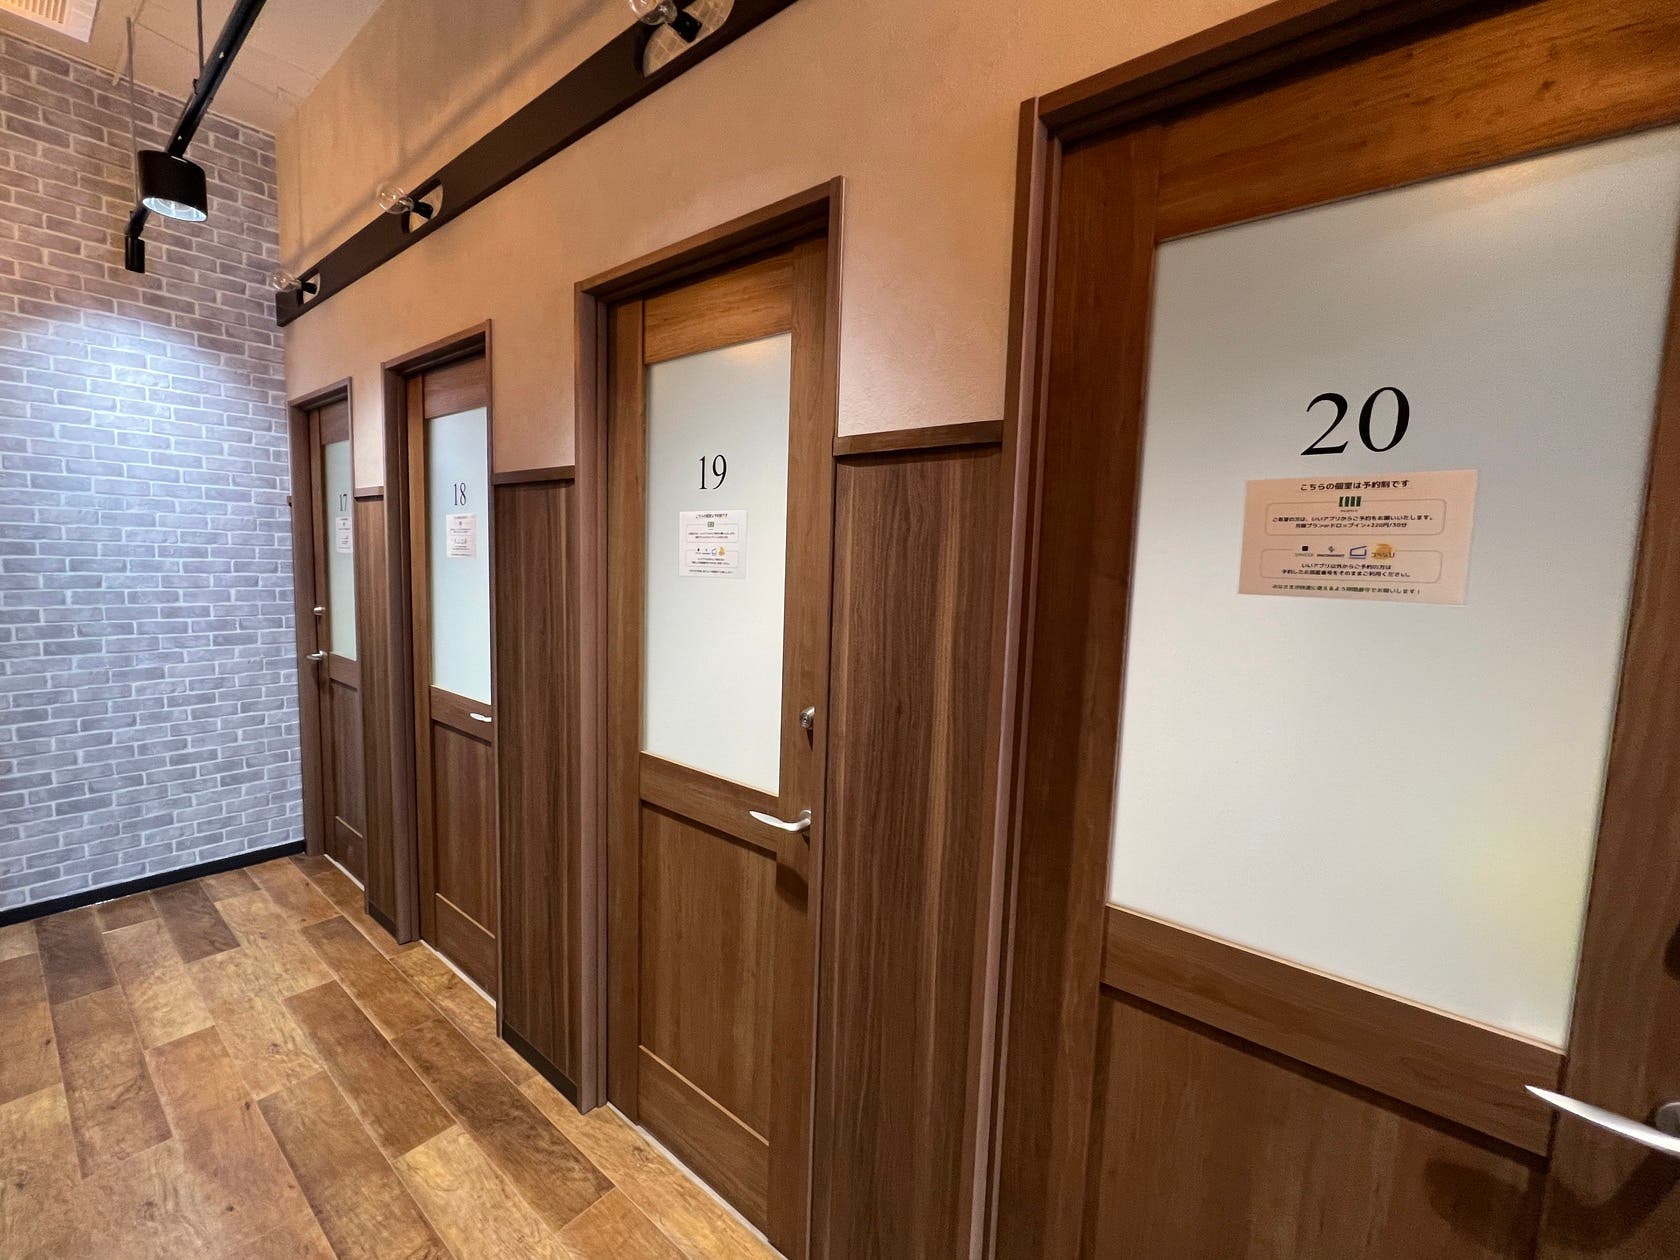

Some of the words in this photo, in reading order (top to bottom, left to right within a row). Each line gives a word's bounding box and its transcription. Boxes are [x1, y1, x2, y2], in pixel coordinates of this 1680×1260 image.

[1300, 386, 1410, 456] 20
[699, 454, 727, 490] 19
[339, 493, 348, 512] 17
[453, 482, 467, 506] 18
